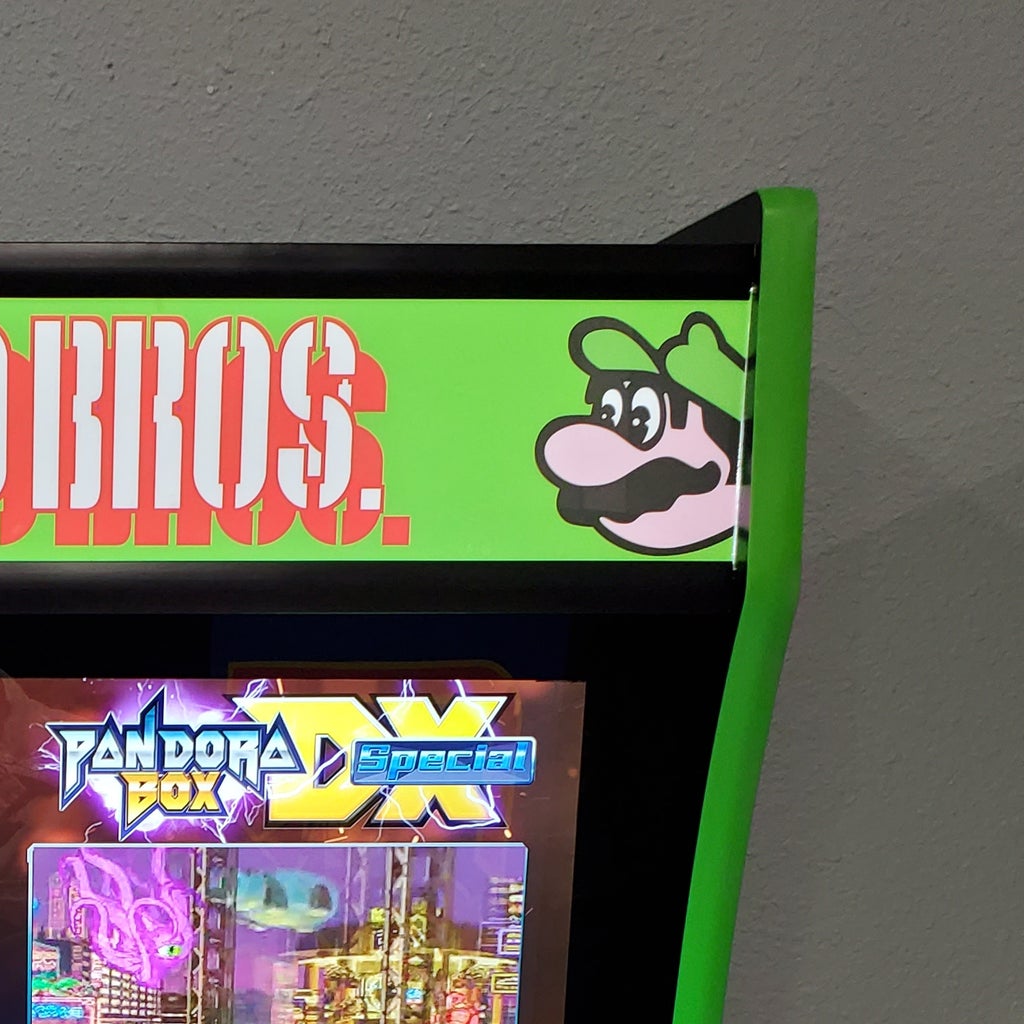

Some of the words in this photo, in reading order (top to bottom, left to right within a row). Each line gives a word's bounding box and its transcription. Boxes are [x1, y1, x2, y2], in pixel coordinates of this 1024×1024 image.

[30, 313, 411, 546] BROS.
[54, 691, 304, 809] PANDORA
[122, 771, 228, 837] BOX
[232, 694, 510, 826] DX
[356, 740, 532, 774] Special
